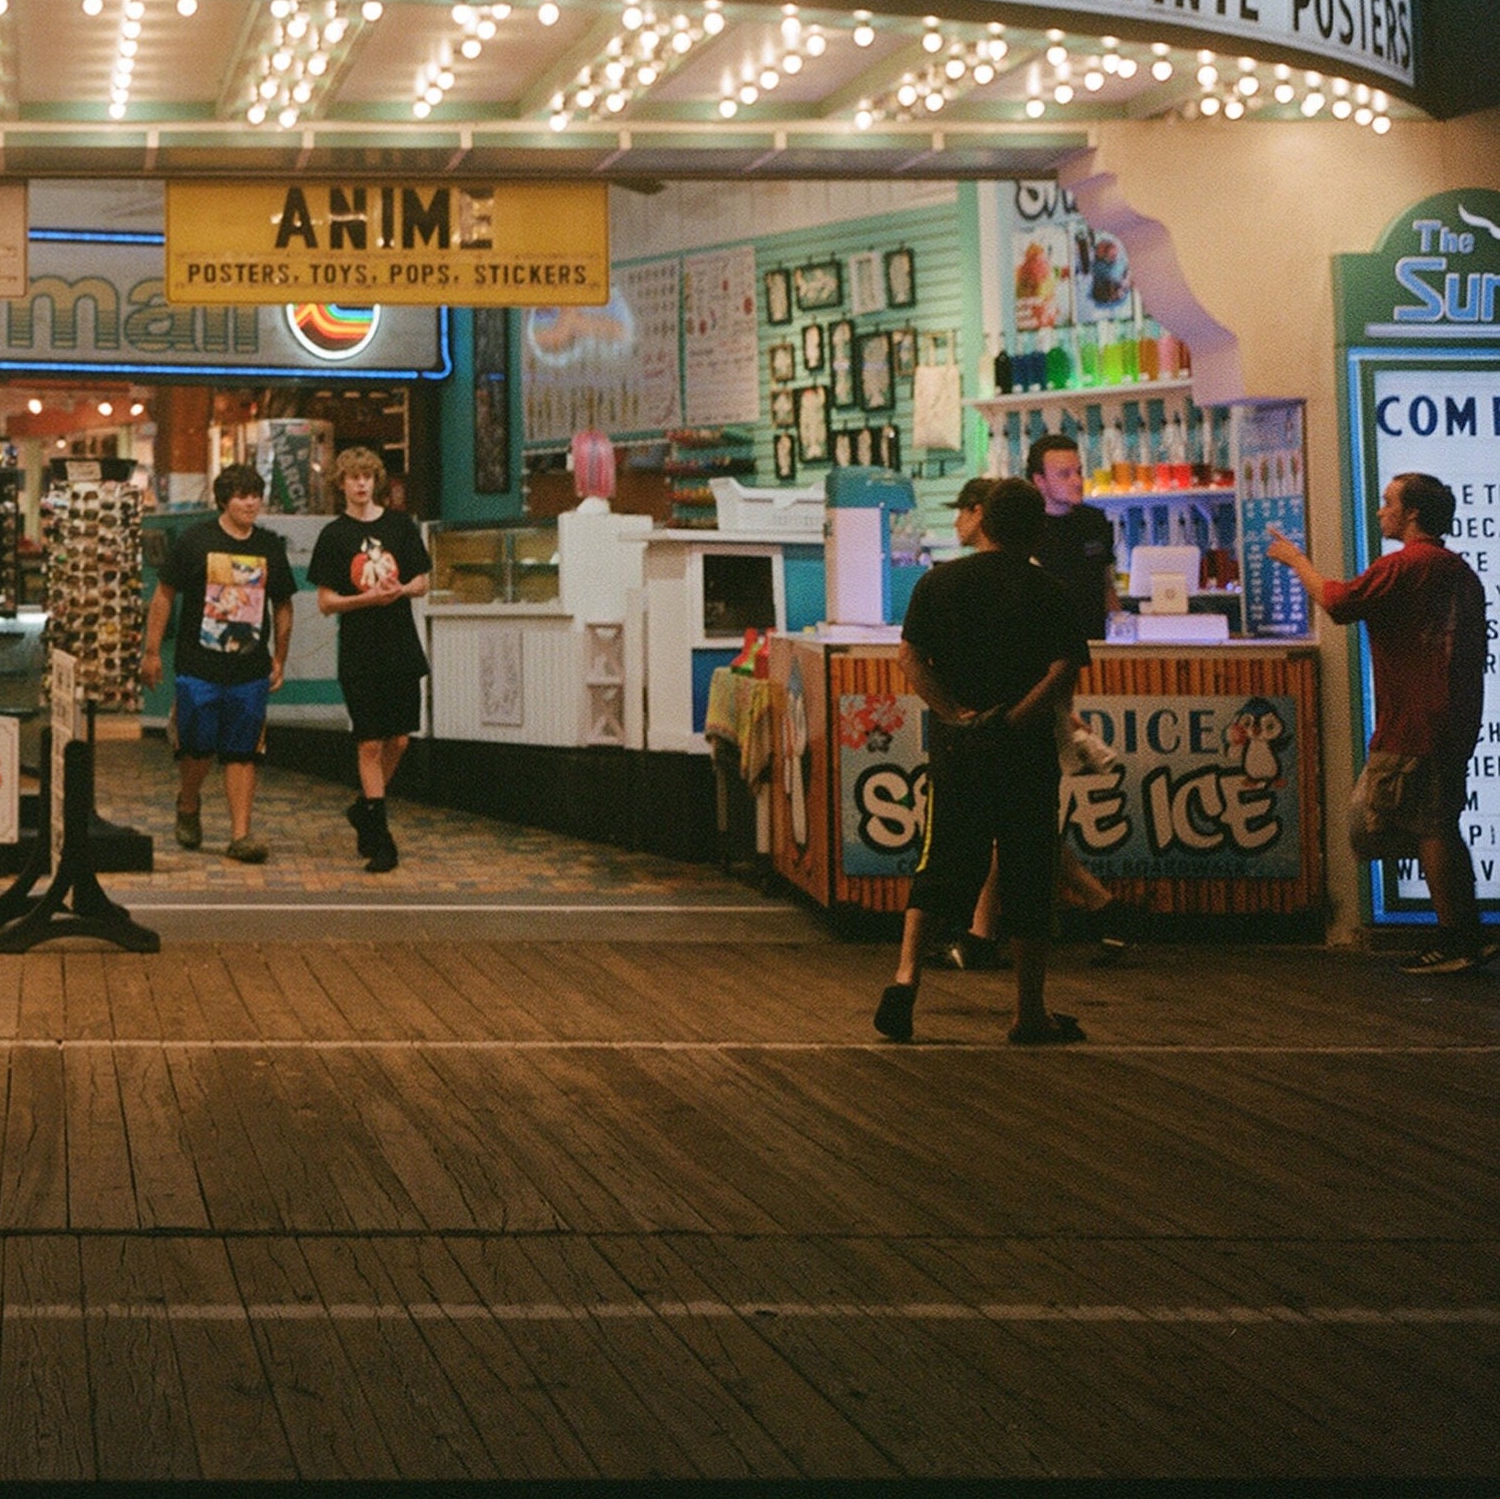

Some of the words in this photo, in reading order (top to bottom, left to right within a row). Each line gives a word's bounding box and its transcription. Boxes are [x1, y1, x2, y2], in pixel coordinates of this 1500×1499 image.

[274, 186, 494, 250] ANIME
[1412, 219, 1475, 254] The
[474, 264, 587, 285] STICKERS
[1142, 764, 1282, 852] ICE
